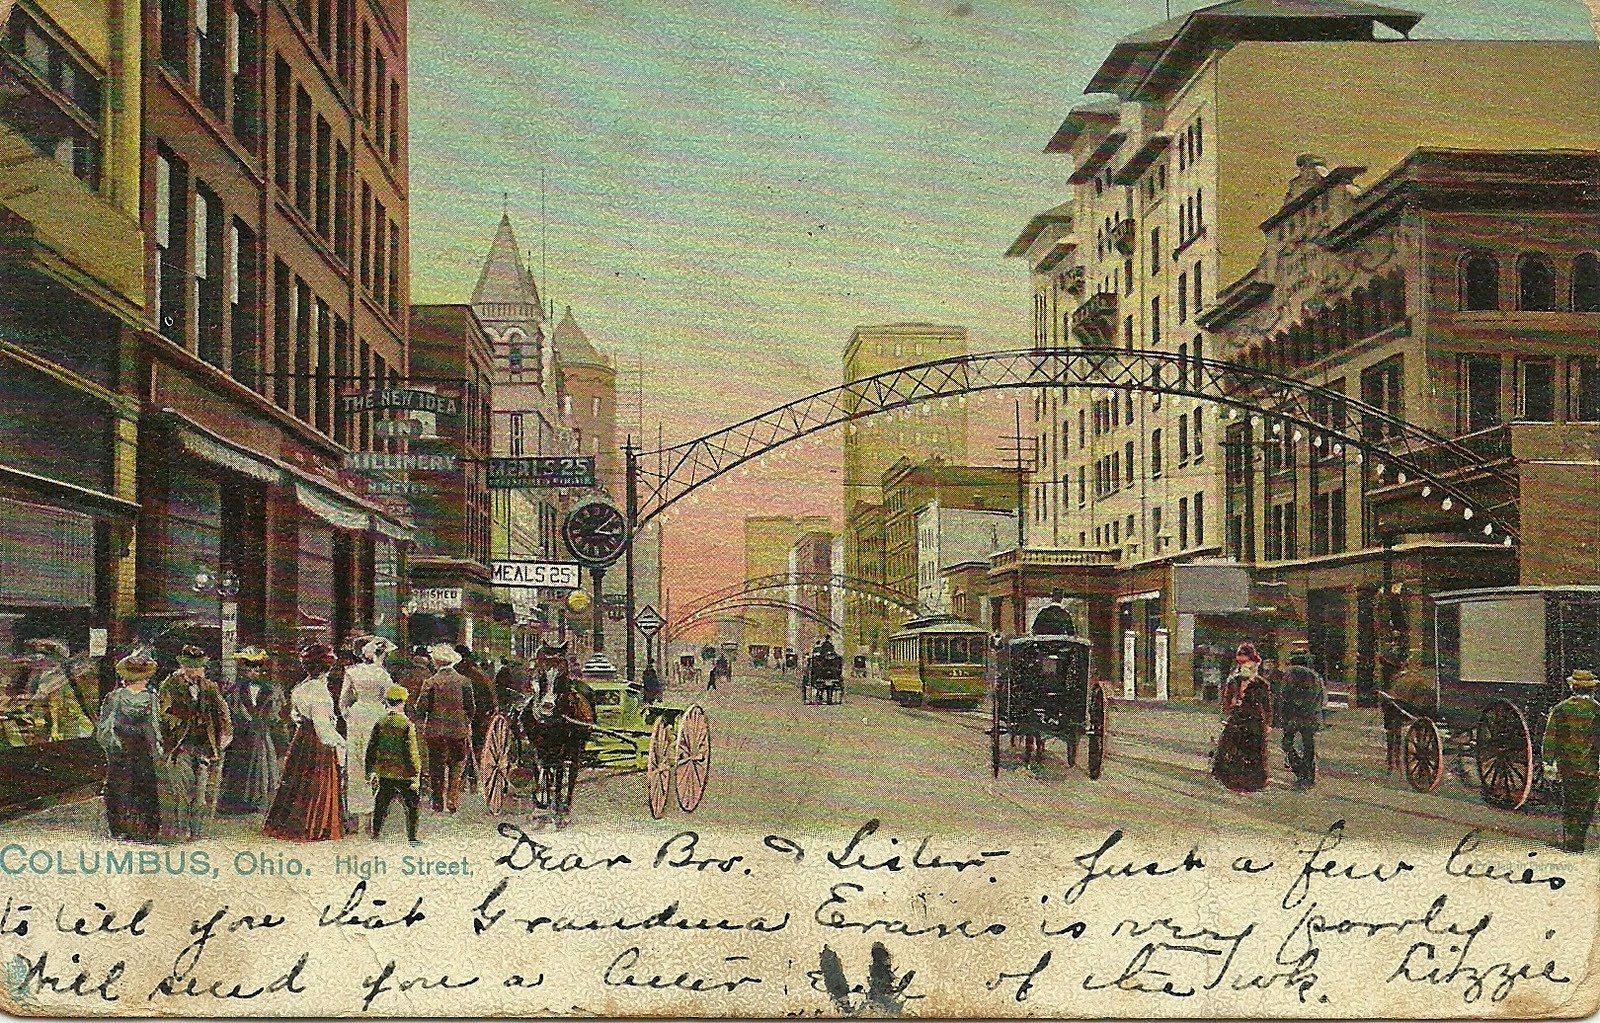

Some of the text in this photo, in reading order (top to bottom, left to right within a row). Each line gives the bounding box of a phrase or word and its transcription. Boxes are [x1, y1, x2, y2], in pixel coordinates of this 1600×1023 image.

[342, 389, 457, 414] THE NEW IDEA
[344, 453, 457, 470] MILLINERY
[491, 565, 545, 583] MEALS
[496, 822, 632, 872] Dear
[1064, 829, 1205, 905] Just
[1230, 855, 1275, 874] a
[1282, 818, 1415, 910] few
[1445, 826, 1567, 891] lines
[172, 905, 286, 980] you
[319, 880, 427, 929] that
[472, 876, 791, 935] Grandma
[1040, 894, 1087, 939] is
[147, 952, 308, 1000] send
[362, 960, 481, 1012] you
[503, 973, 544, 988] a
[986, 950, 1052, 1001] of
[1083, 943, 1196, 998] the
